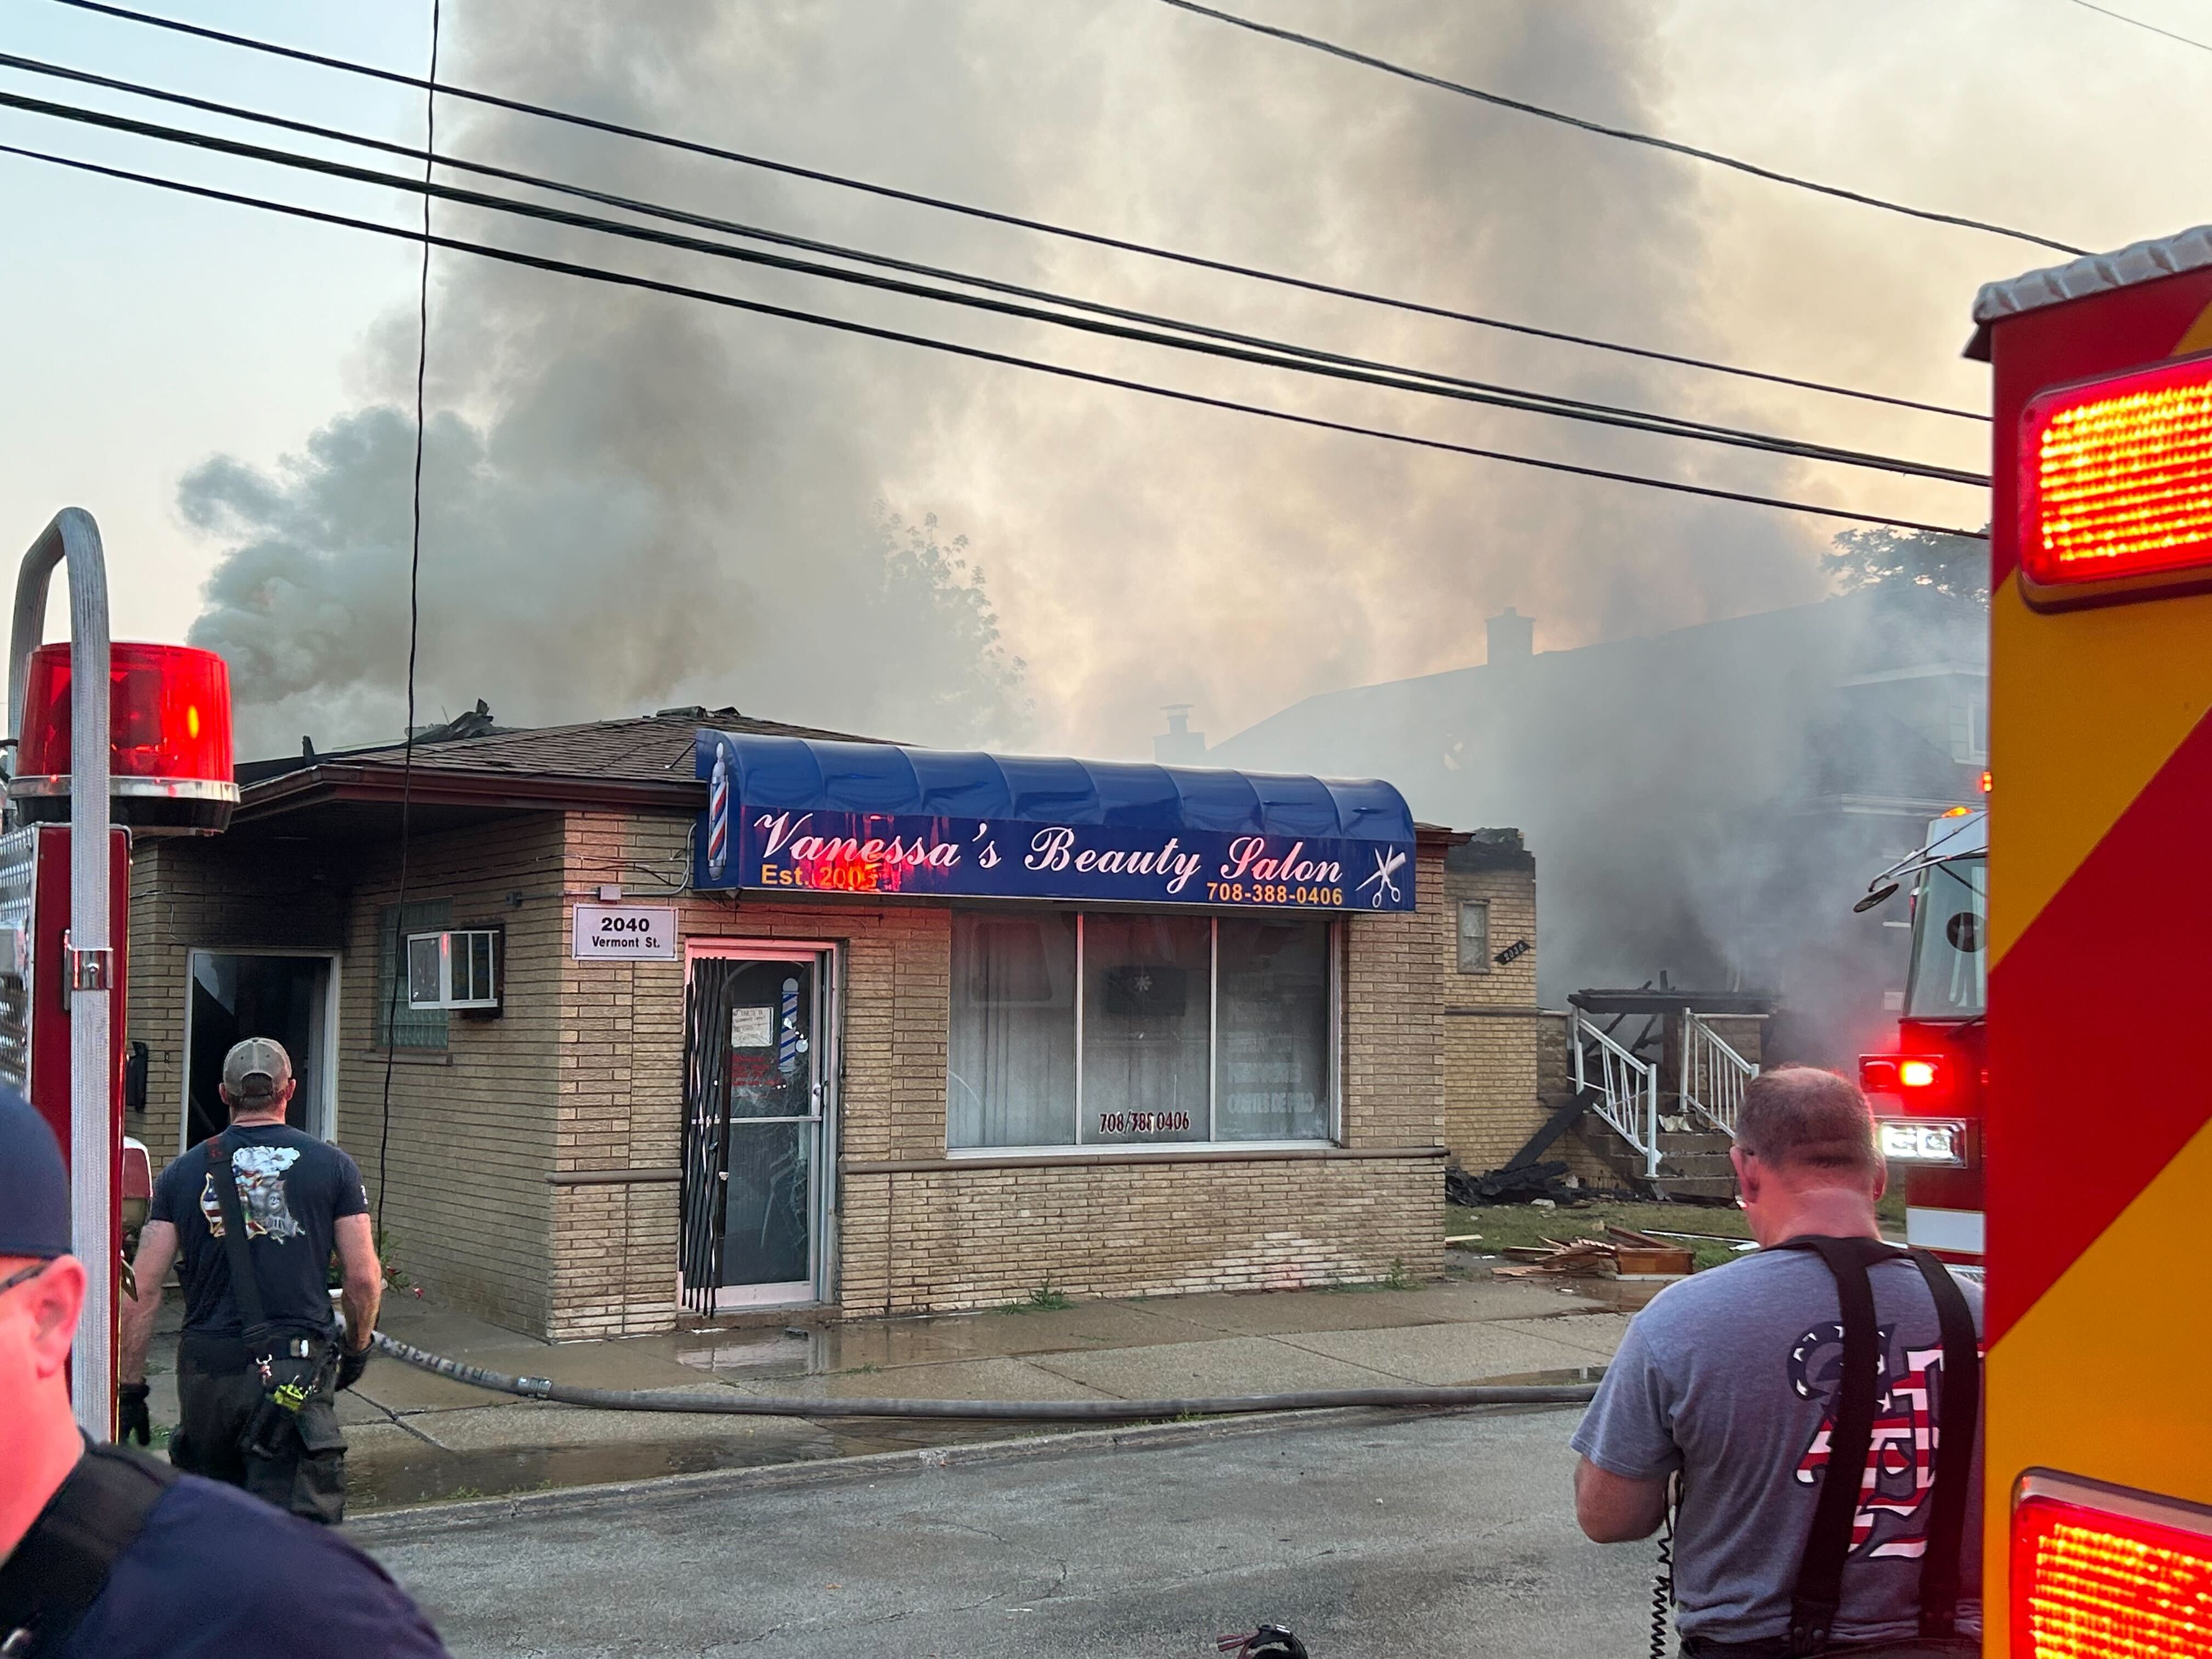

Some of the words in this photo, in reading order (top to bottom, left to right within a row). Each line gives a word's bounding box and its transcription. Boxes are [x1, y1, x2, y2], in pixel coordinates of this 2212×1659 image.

[753, 811, 1002, 869] Vanessa's
[1024, 826, 1201, 894] Beauty
[1220, 836, 1343, 883] Salon
[761, 864, 809, 886] Est.
[1206, 882, 1343, 905] 708-388-0406
[601, 917, 650, 932] 2040
[592, 935, 640, 948] Vermont
[645, 936, 661, 948] St.
